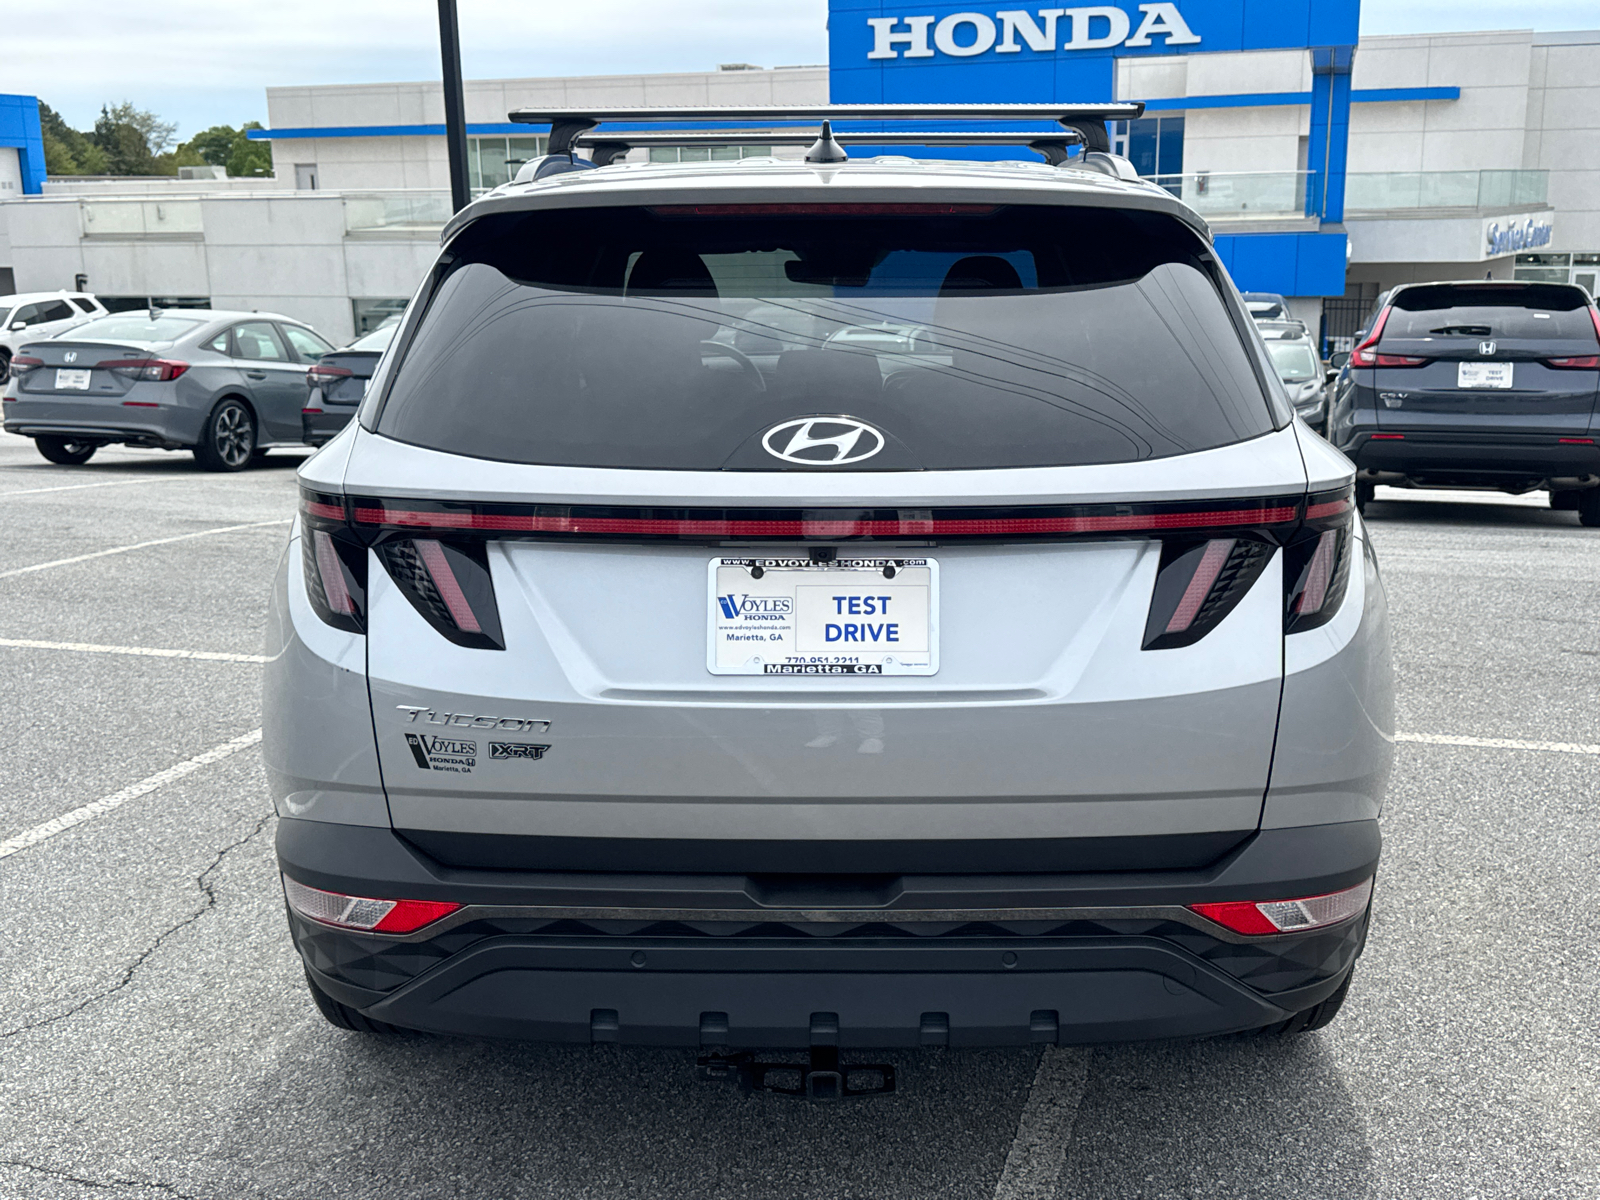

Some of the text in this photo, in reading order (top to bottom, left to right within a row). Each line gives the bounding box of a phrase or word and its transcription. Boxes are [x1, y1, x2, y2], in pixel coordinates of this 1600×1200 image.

[867, 2, 1201, 59] HONDA
[832, 596, 892, 615] TEST
[726, 633, 784, 642] Marietta, GA
[825, 624, 899, 642] DRIVE
[766, 664, 880, 673] Marietta, GA
[408, 737, 419, 746] ED
[497, 743, 550, 760] XRT
[429, 756, 466, 765] HONDA
[432, 764, 460, 773] Marietta,
